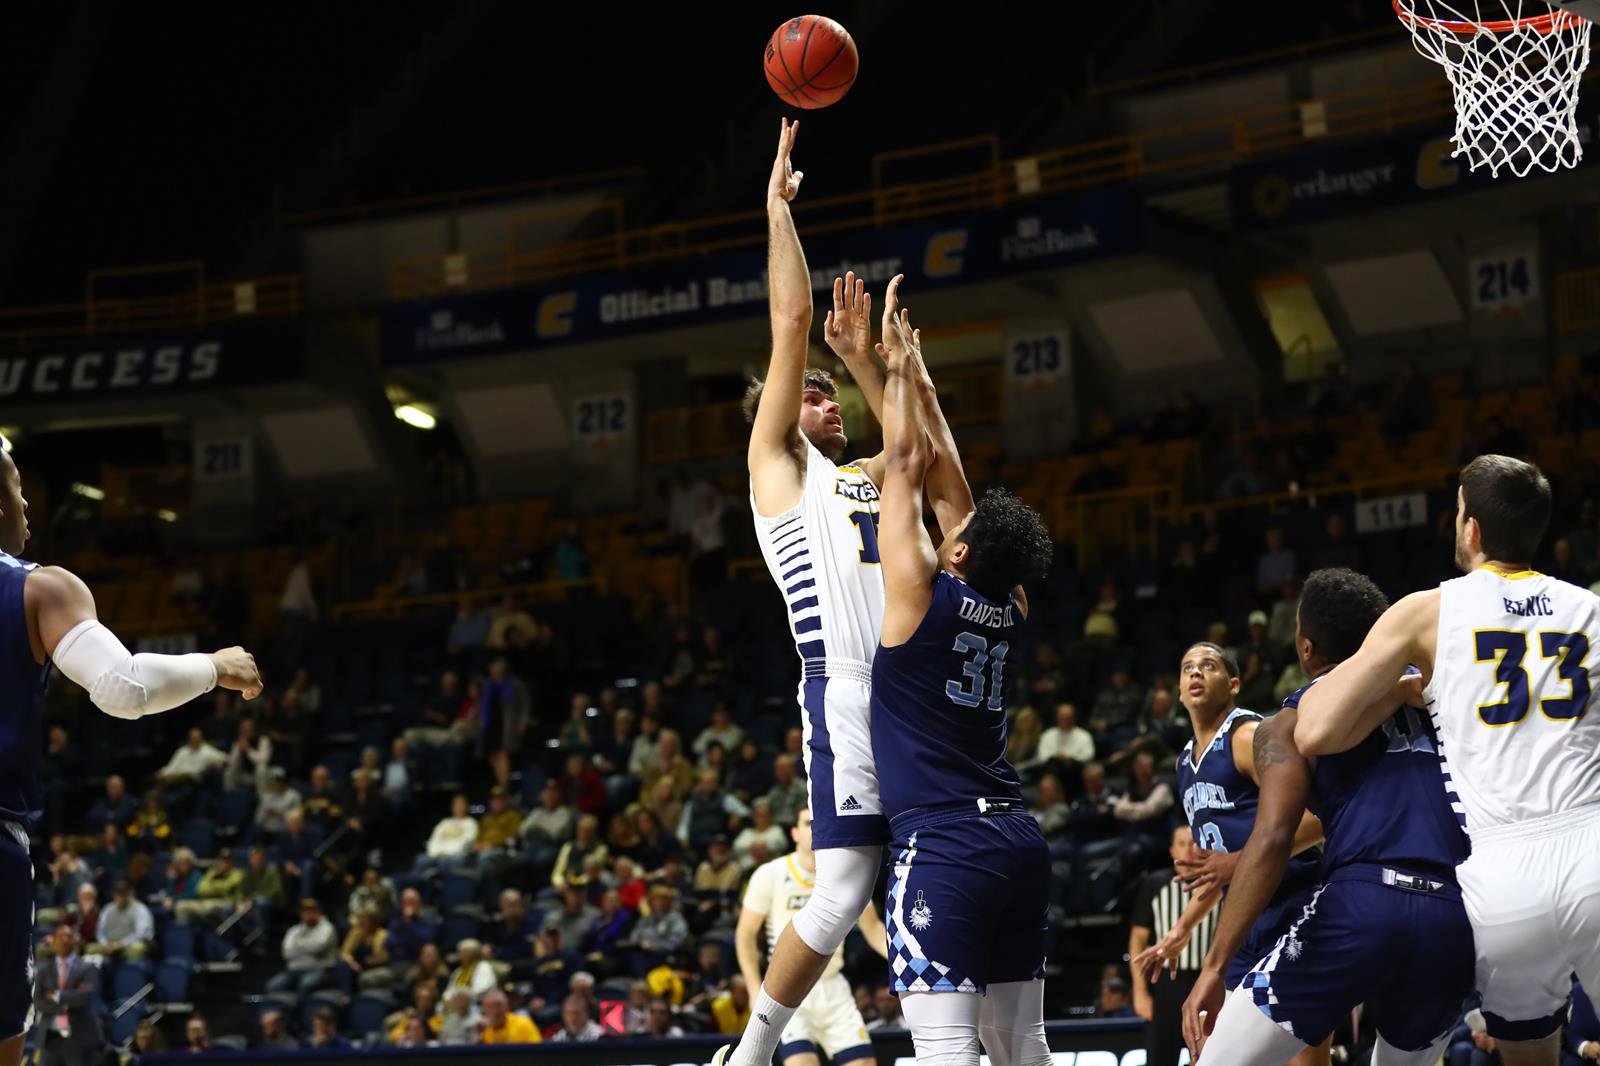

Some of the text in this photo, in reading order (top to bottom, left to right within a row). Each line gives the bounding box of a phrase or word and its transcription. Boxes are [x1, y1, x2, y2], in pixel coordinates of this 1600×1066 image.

[599, 279, 700, 324] Official
[1477, 257, 1529, 302] 214
[1014, 337, 1060, 375] 213
[578, 398, 626, 435] 212
[204, 443, 242, 473] 211
[945, 631, 1010, 712] 31
[1472, 628, 1592, 728] 33
